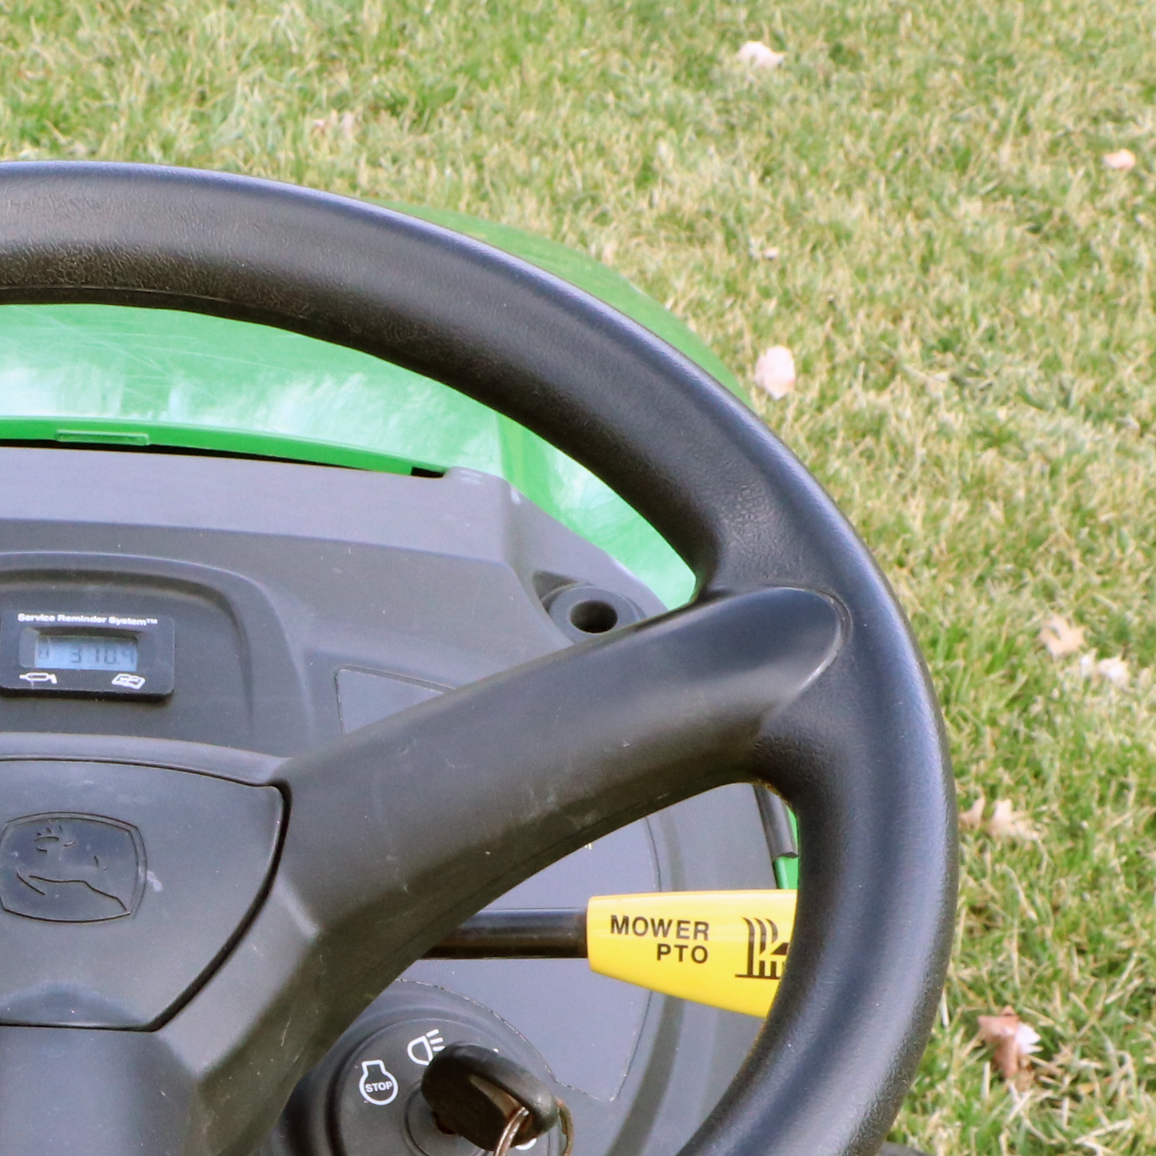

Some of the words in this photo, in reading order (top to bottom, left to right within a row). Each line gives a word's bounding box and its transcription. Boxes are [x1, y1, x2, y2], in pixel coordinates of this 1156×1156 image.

[17, 613, 56, 622] Service
[57, 614, 107, 624] Reminder
[610, 914, 710, 941] MOWER
[656, 943, 709, 964] PTO
[365, 1081, 394, 1093] STOP
